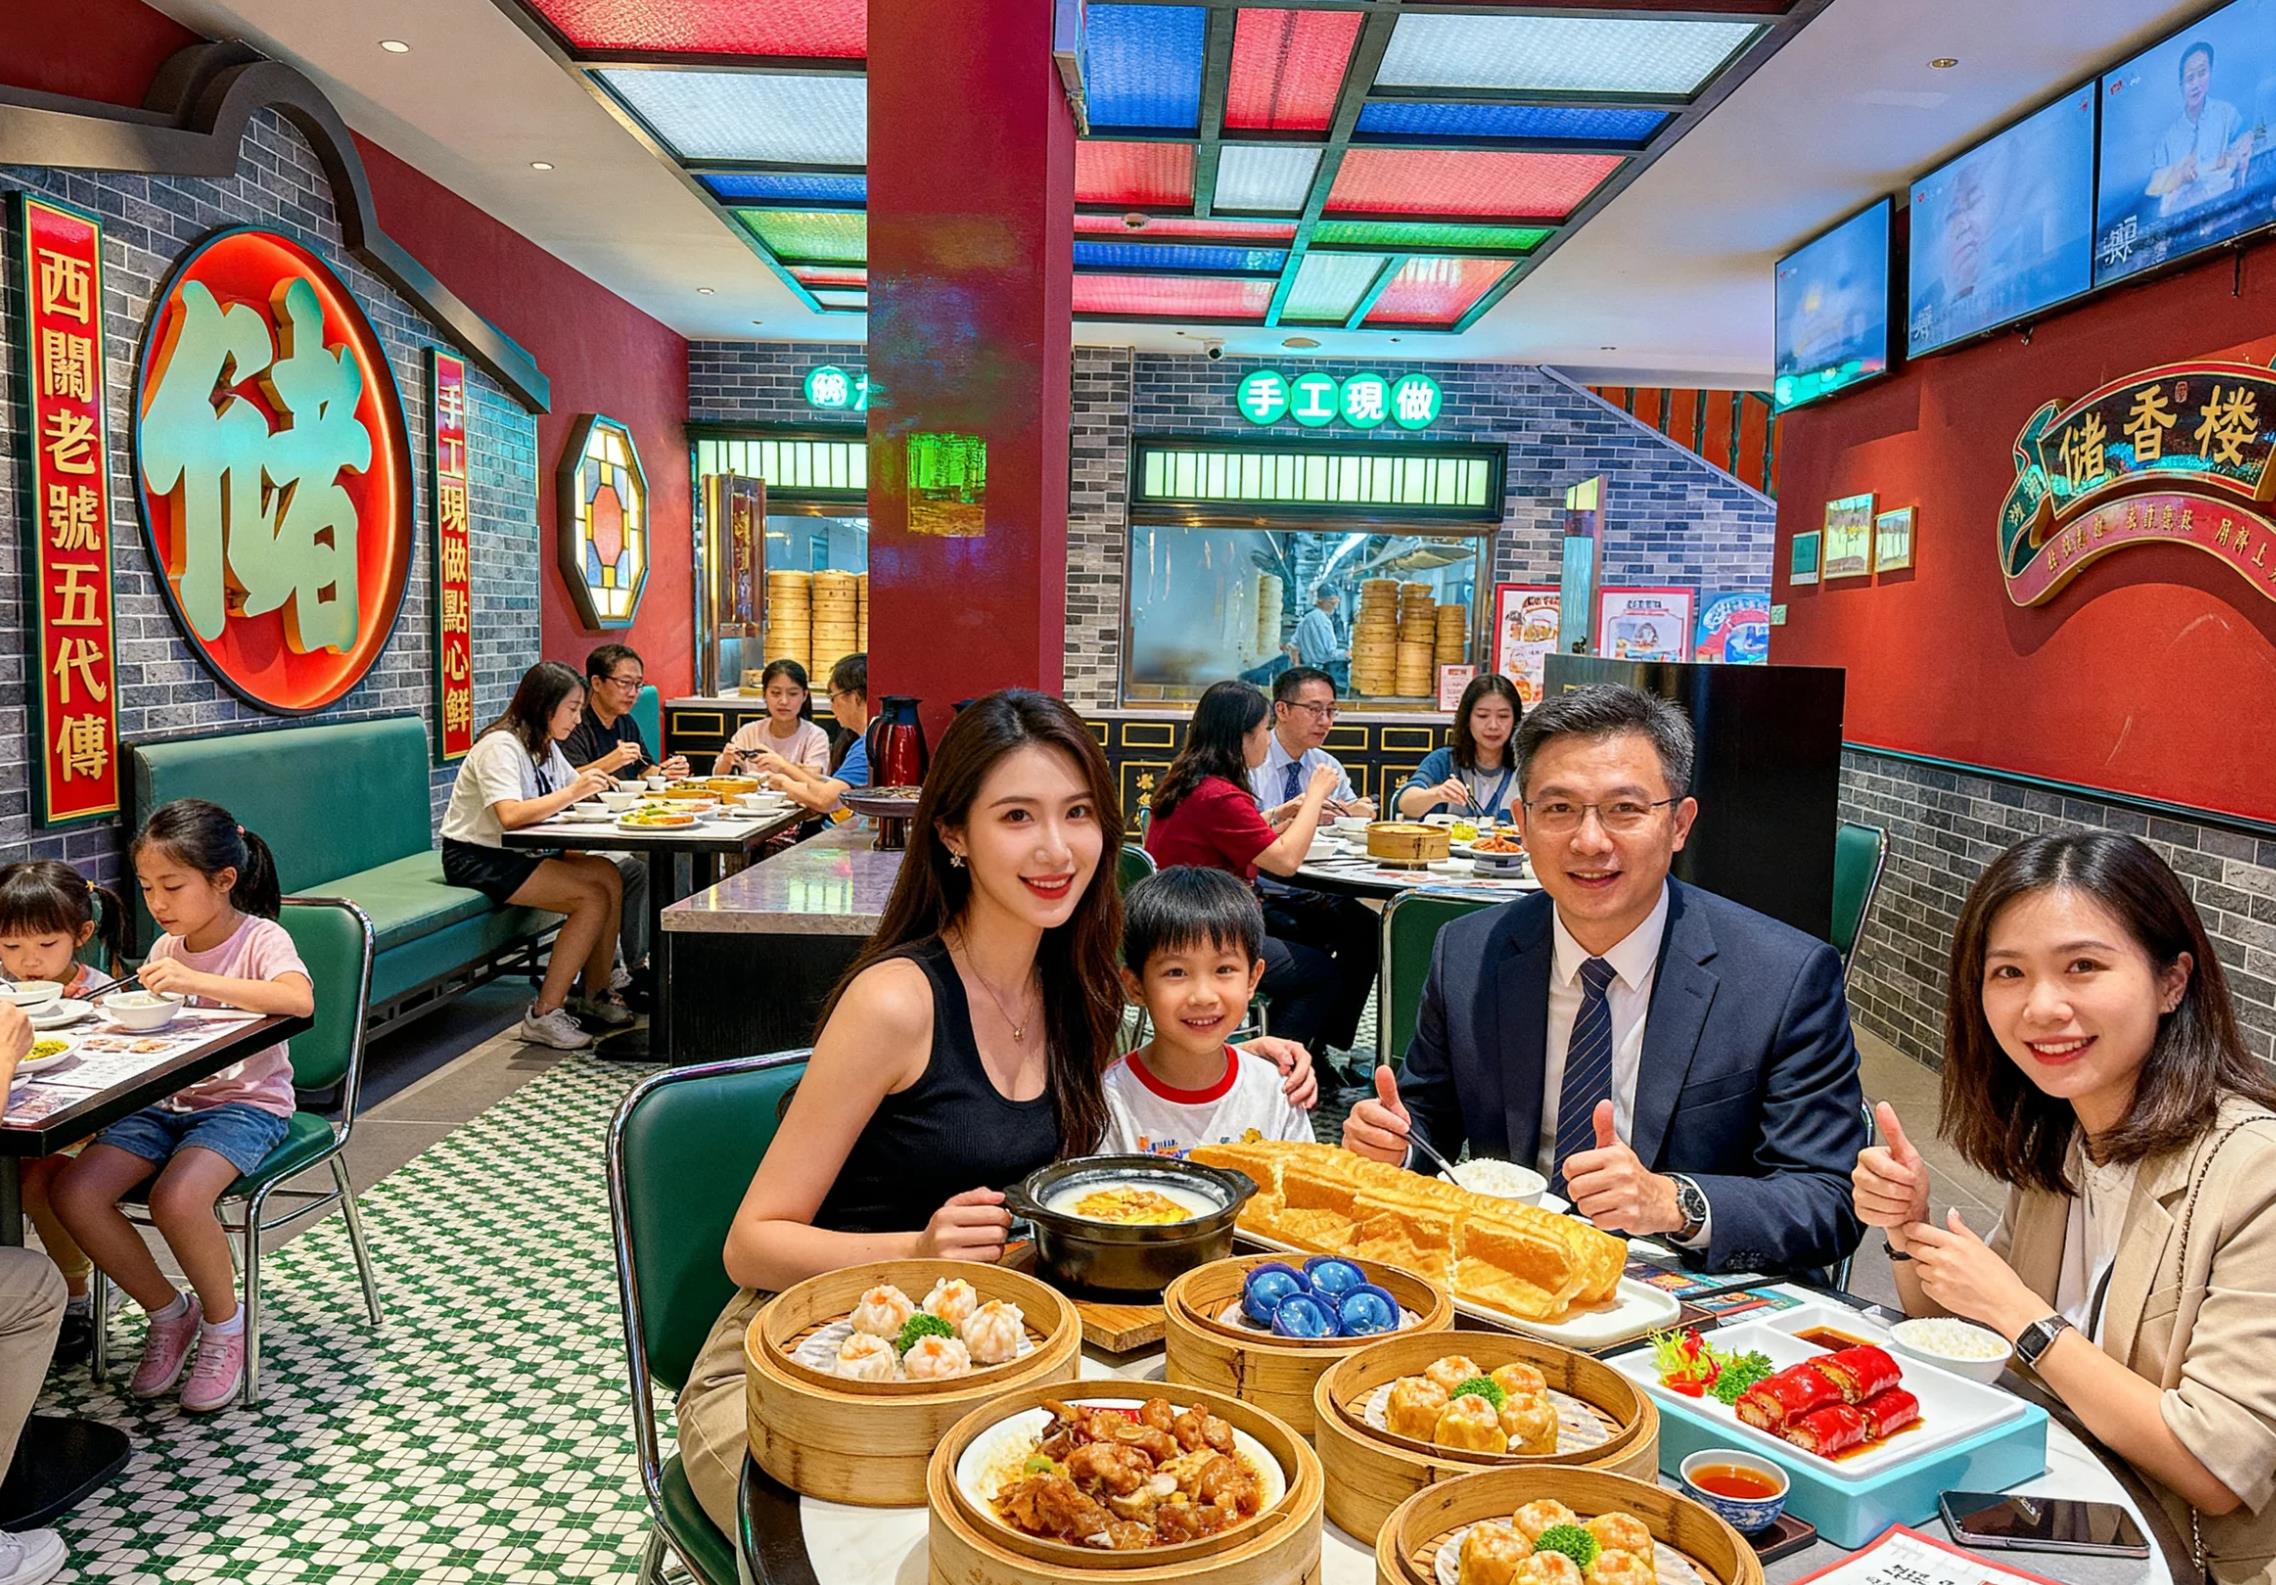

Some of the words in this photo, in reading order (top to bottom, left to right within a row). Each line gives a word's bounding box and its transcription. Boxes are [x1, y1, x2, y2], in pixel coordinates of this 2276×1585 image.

[1246, 378, 1434, 421] 手工現做
[440, 383, 470, 733] 手工現做點心鮮
